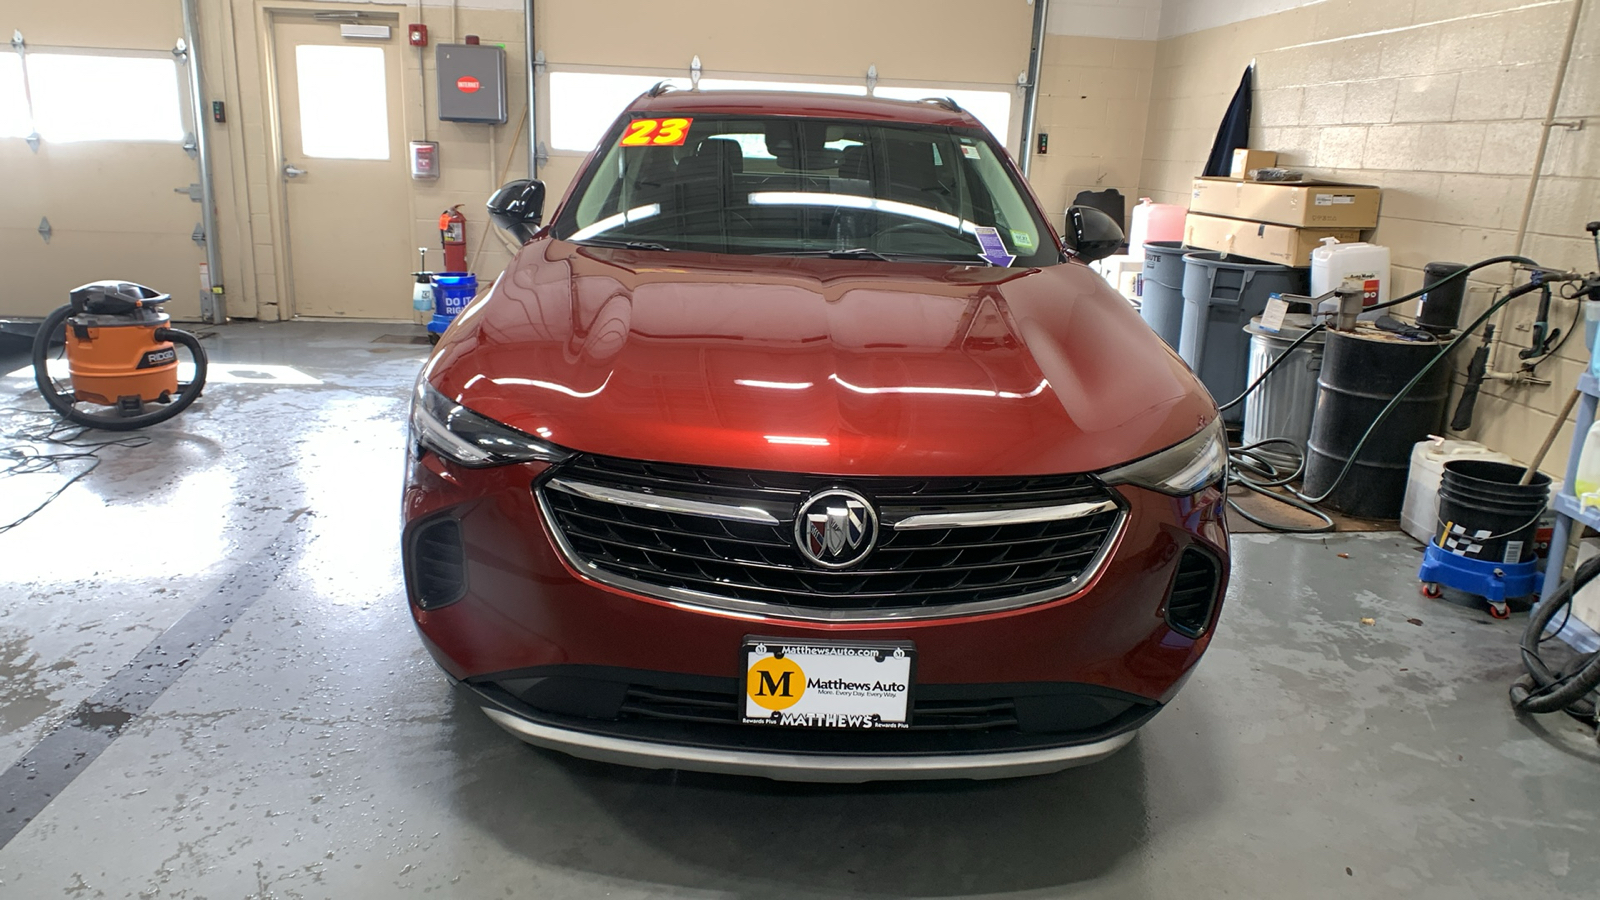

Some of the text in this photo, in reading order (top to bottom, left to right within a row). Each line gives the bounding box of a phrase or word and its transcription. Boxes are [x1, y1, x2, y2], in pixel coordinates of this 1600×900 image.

[621, 118, 689, 145] 23
[445, 296, 471, 306] DO IT
[781, 646, 879, 657] MatthewsAuto.com
[754, 670, 795, 698] M
[806, 677, 906, 692] Matthews Auto
[780, 713, 873, 728] MATTHEWS
